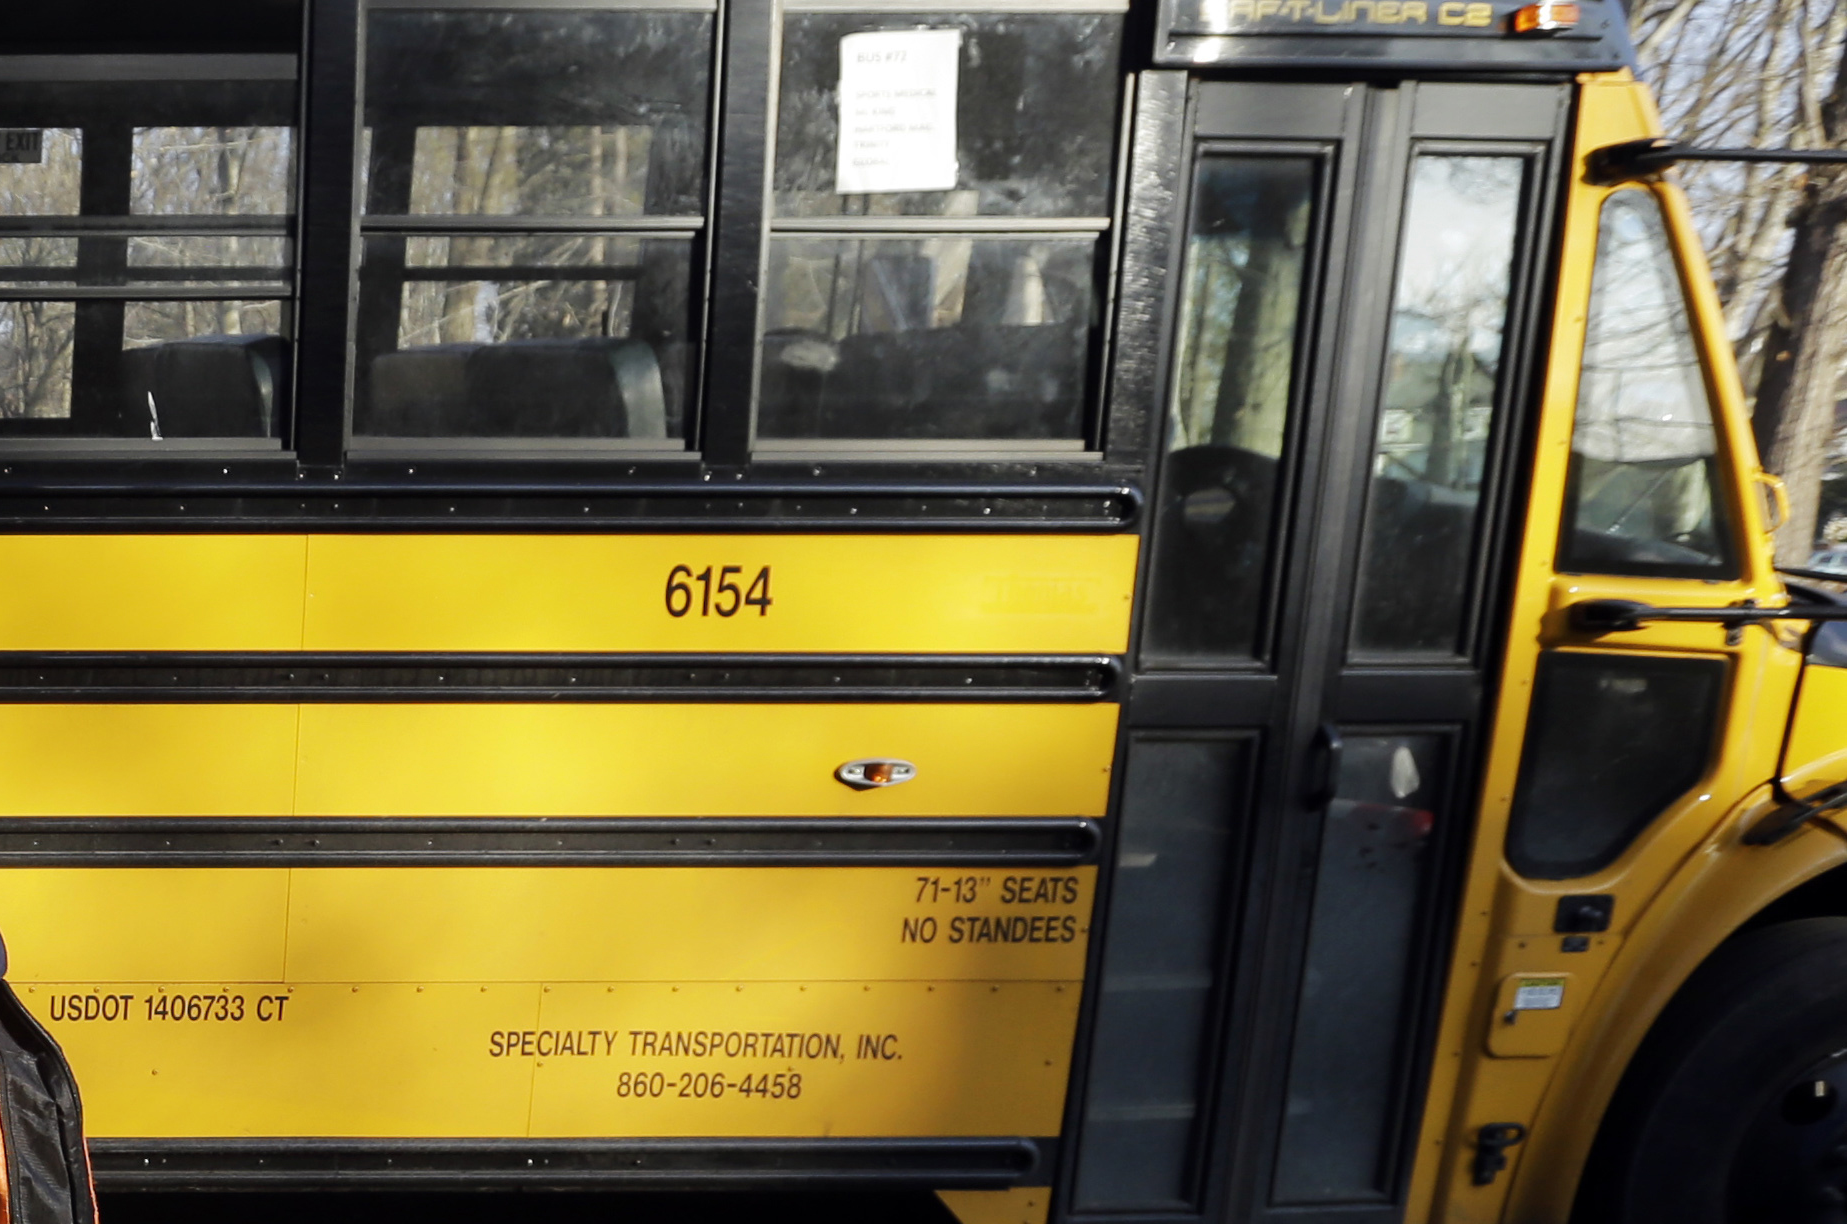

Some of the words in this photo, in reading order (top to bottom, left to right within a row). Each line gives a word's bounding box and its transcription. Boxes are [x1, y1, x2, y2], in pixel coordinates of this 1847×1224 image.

[1198, 0, 1429, 24] AF-T-LINER
[1438, 1, 1493, 27] C2
[857, 51, 882, 63] BUS
[6, 131, 39, 151] EXIT
[665, 565, 772, 618] 6154
[1001, 876, 1078, 904] SEATS
[902, 917, 938, 943] NO
[949, 916, 1077, 944] STANDEES
[50, 994, 134, 1021] USDOT
[144, 994, 245, 1021] 1406733
[256, 994, 290, 1021] CT
[489, 1031, 617, 1058] SPECIALTY
[629, 1032, 845, 1065] TRANSPORTATION,
[857, 1034, 903, 1061] INC.
[616, 1072, 802, 1100] 860-206-4458
